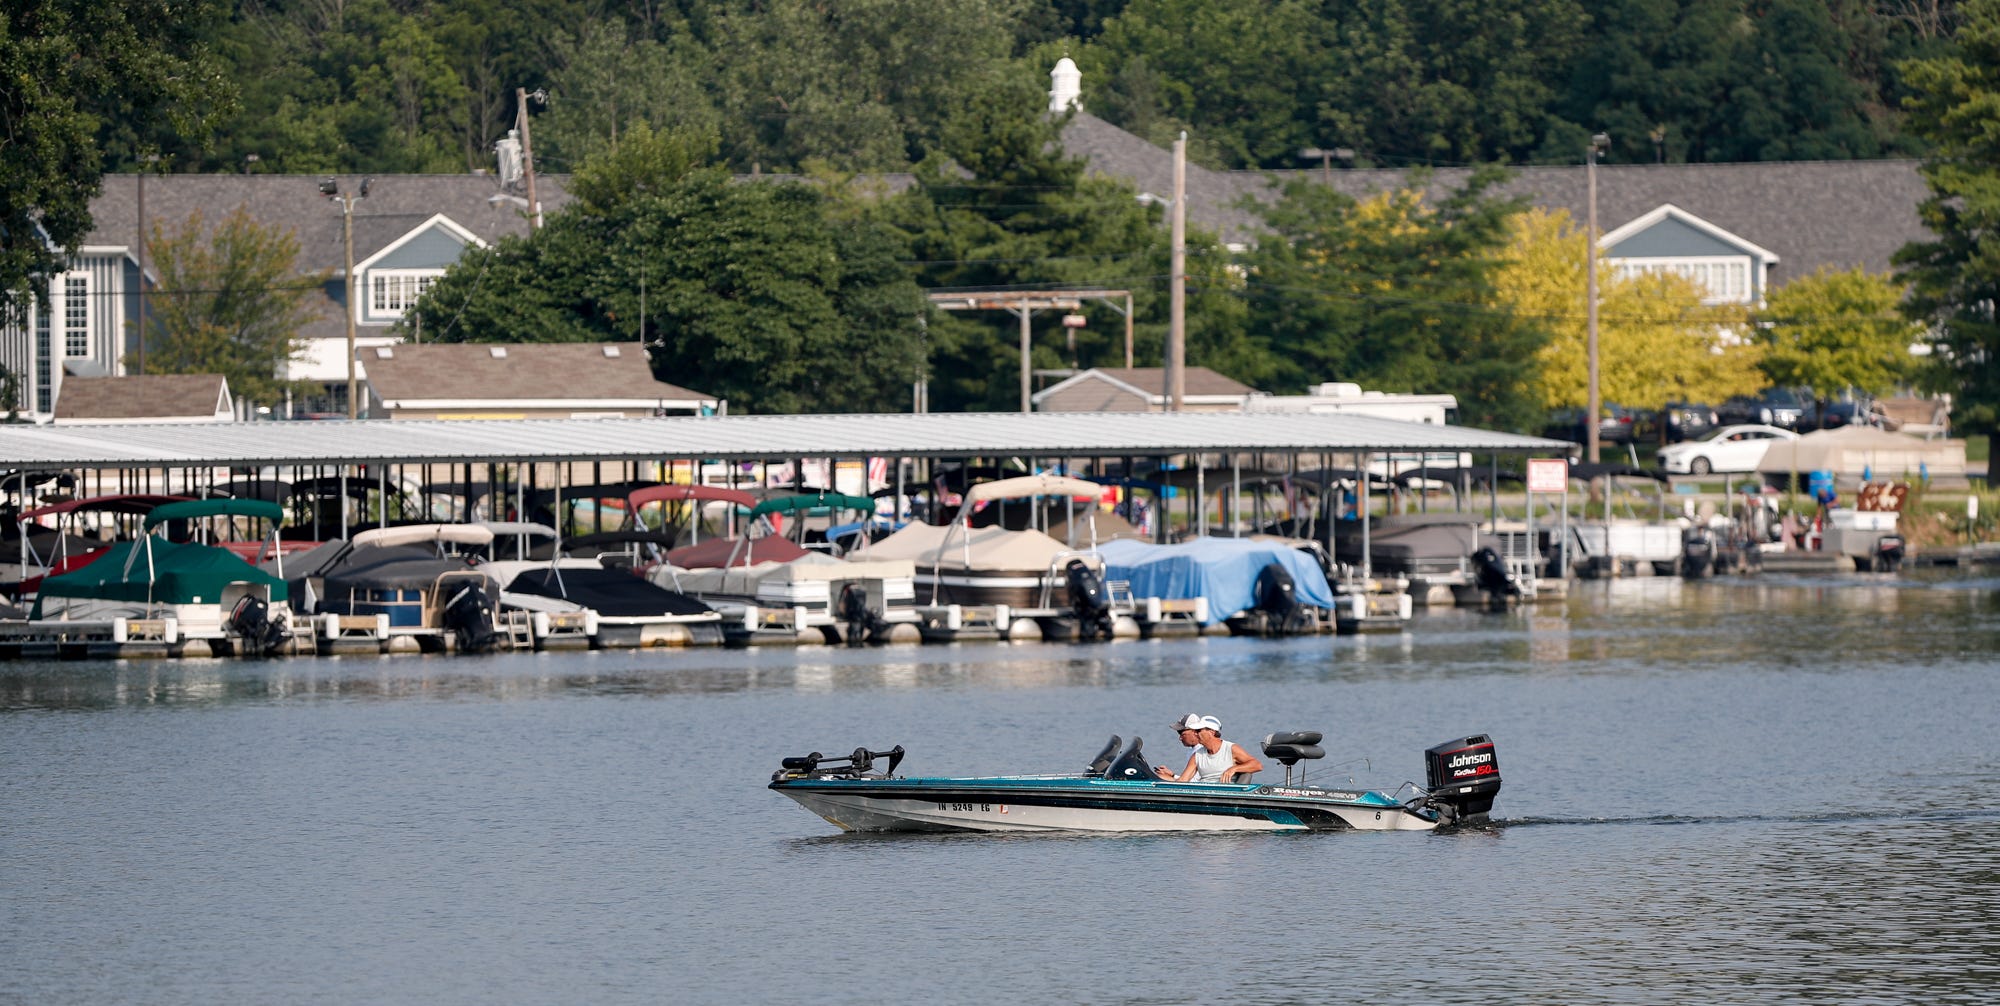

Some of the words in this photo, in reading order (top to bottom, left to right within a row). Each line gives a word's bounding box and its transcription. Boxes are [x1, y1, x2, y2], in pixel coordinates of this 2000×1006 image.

[1449, 753, 1491, 768] Johnson
[1476, 765, 1492, 776] 150
[1273, 787, 1325, 796] Ranger
[939, 803, 946, 811] IN
[953, 803, 972, 811] 5249
[1375, 811, 1382, 821] 6
